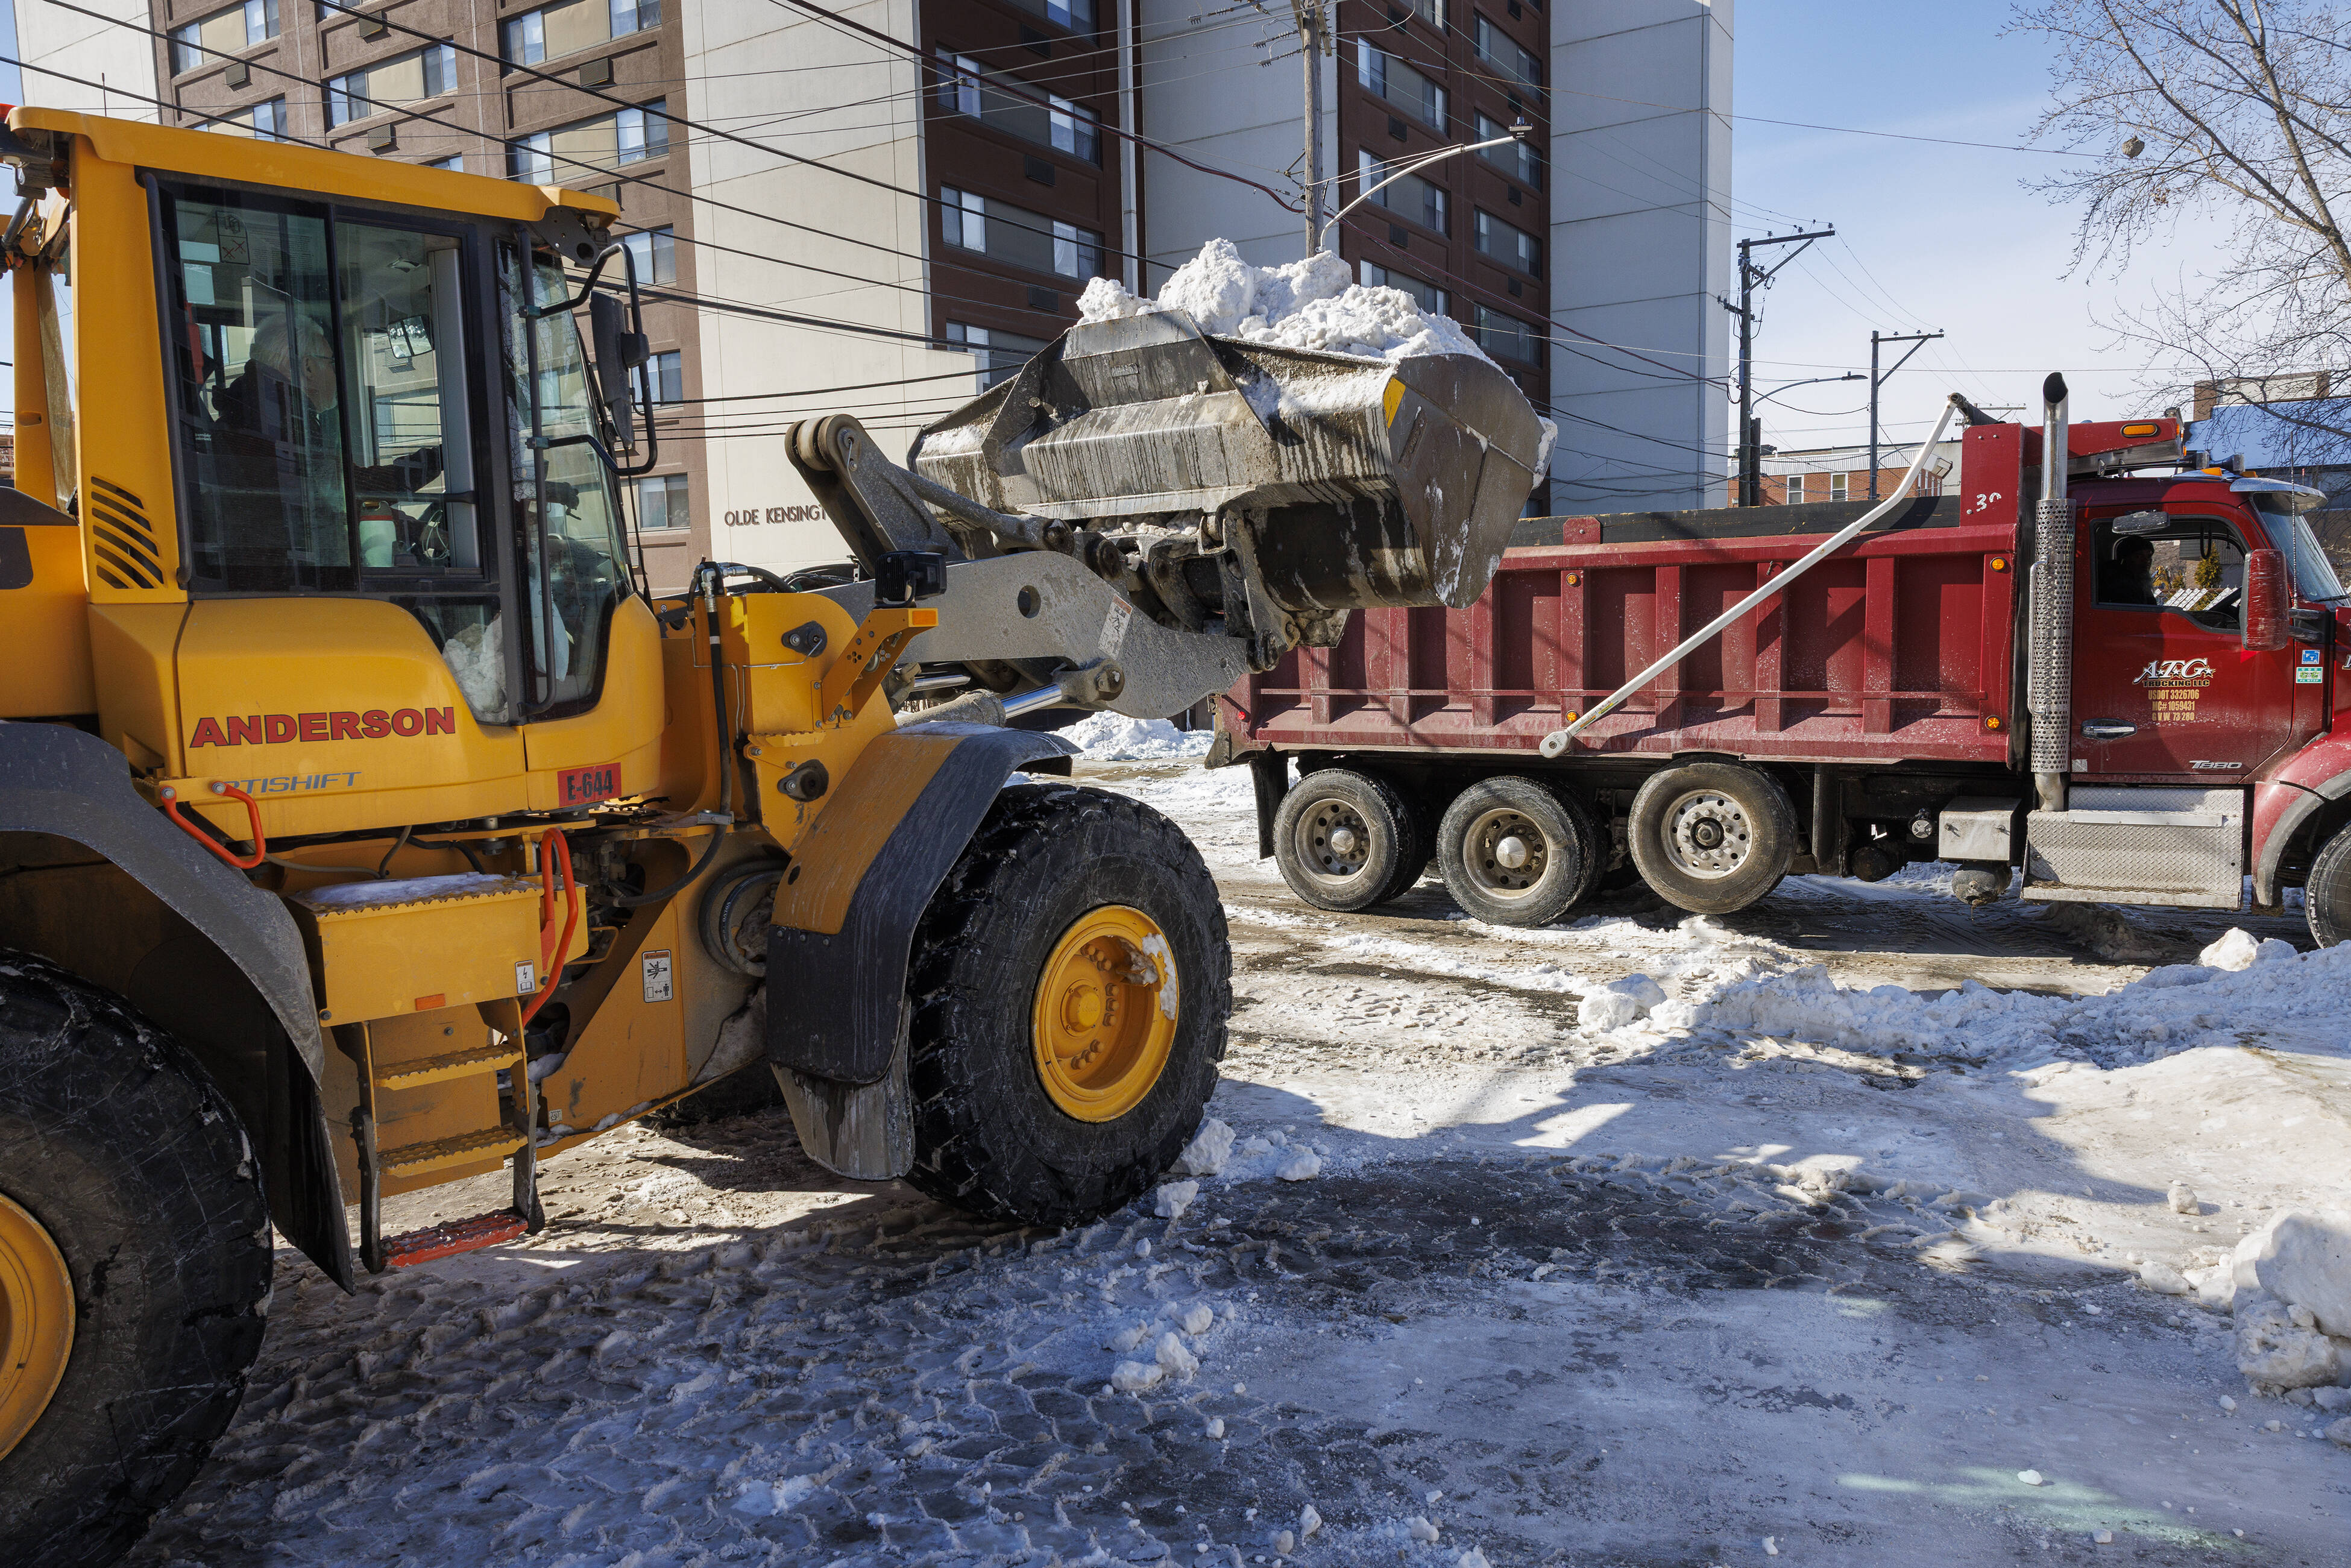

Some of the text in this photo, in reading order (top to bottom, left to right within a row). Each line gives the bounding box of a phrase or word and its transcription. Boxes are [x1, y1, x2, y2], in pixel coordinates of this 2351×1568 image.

[724, 509, 760, 526] OLDE
[2132, 658, 2209, 684] ATG
[2148, 689, 2200, 700] USDOT 3326706
[2152, 701, 2195, 711] MC# 1059431
[189, 707, 456, 748] ANDERSON
[2189, 760, 2242, 769] T880
[222, 772, 362, 794] PTISHIFT
[567, 770, 614, 801] E-644
